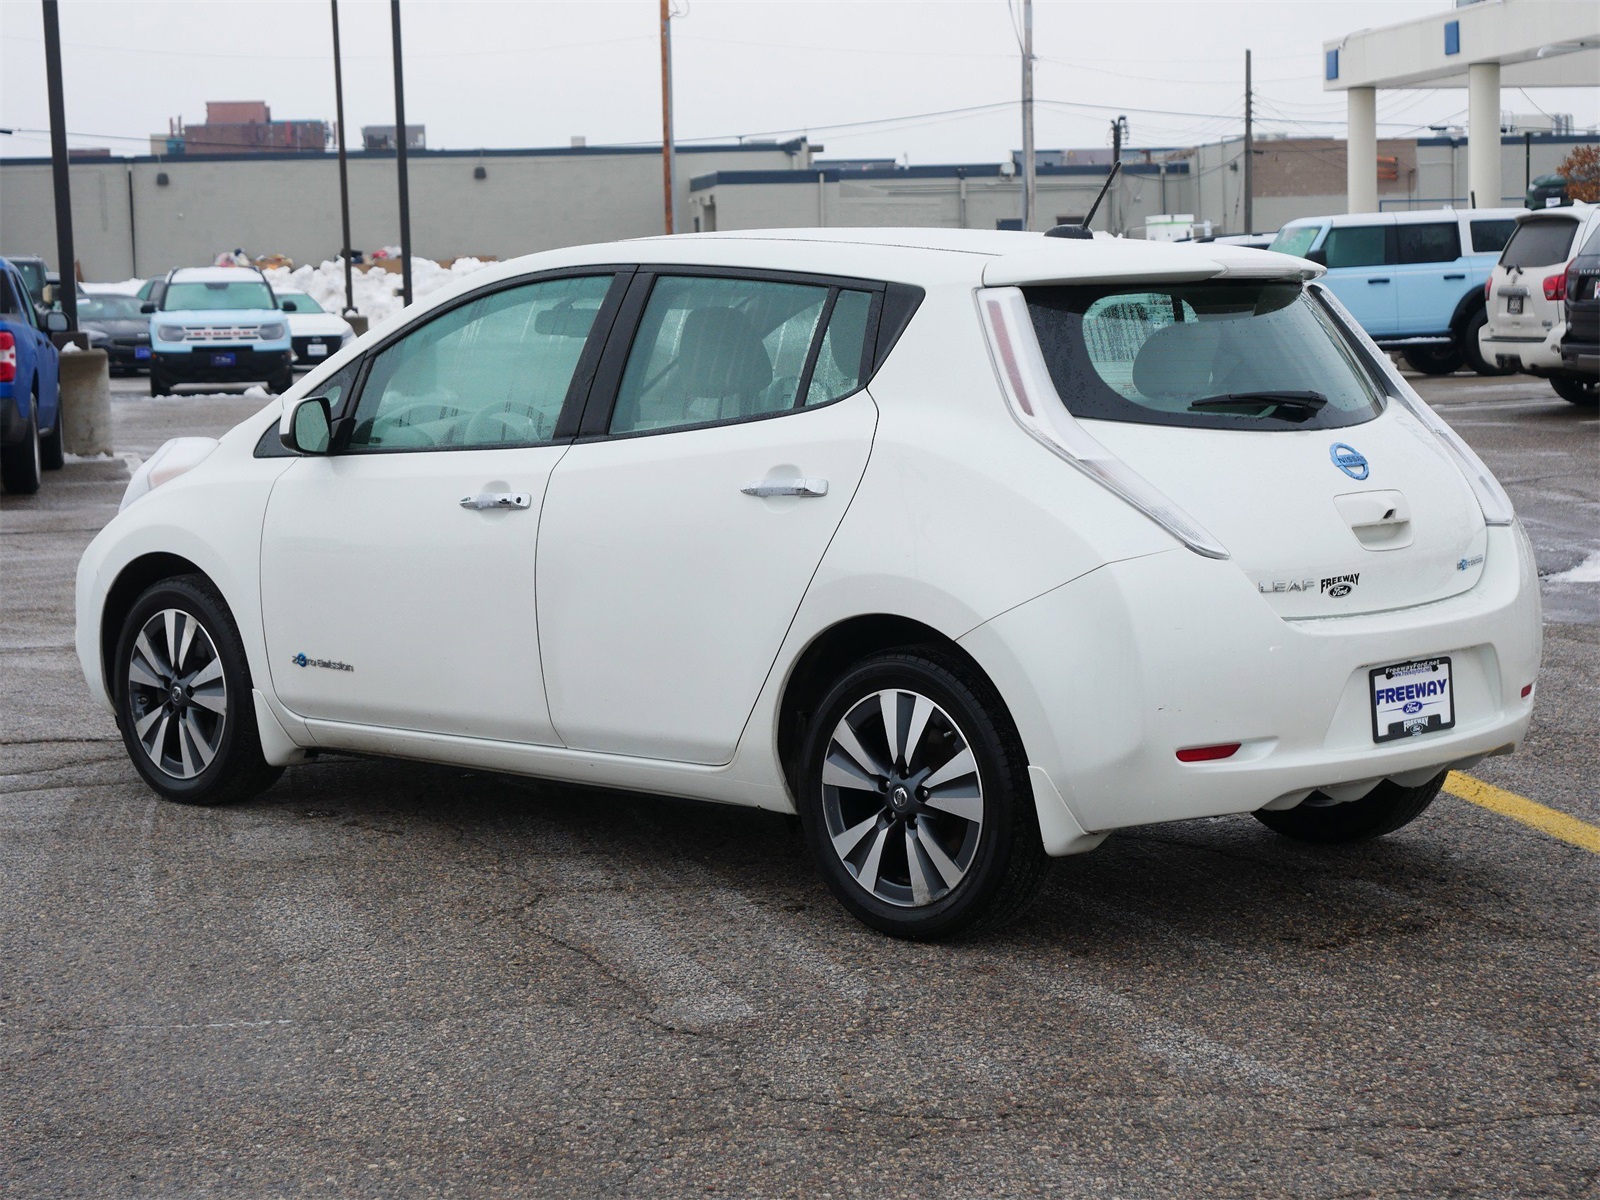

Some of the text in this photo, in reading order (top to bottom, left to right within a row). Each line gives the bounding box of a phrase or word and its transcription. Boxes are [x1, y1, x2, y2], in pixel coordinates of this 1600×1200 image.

[1258, 578, 1315, 594] LEAF
[1320, 572, 1360, 594] FREEWAY
[1331, 585, 1349, 597] Ford
[1376, 679, 1447, 705] FREEWAY
[1404, 702, 1421, 713] Ford
[1404, 716, 1429, 732] FREEWAY
